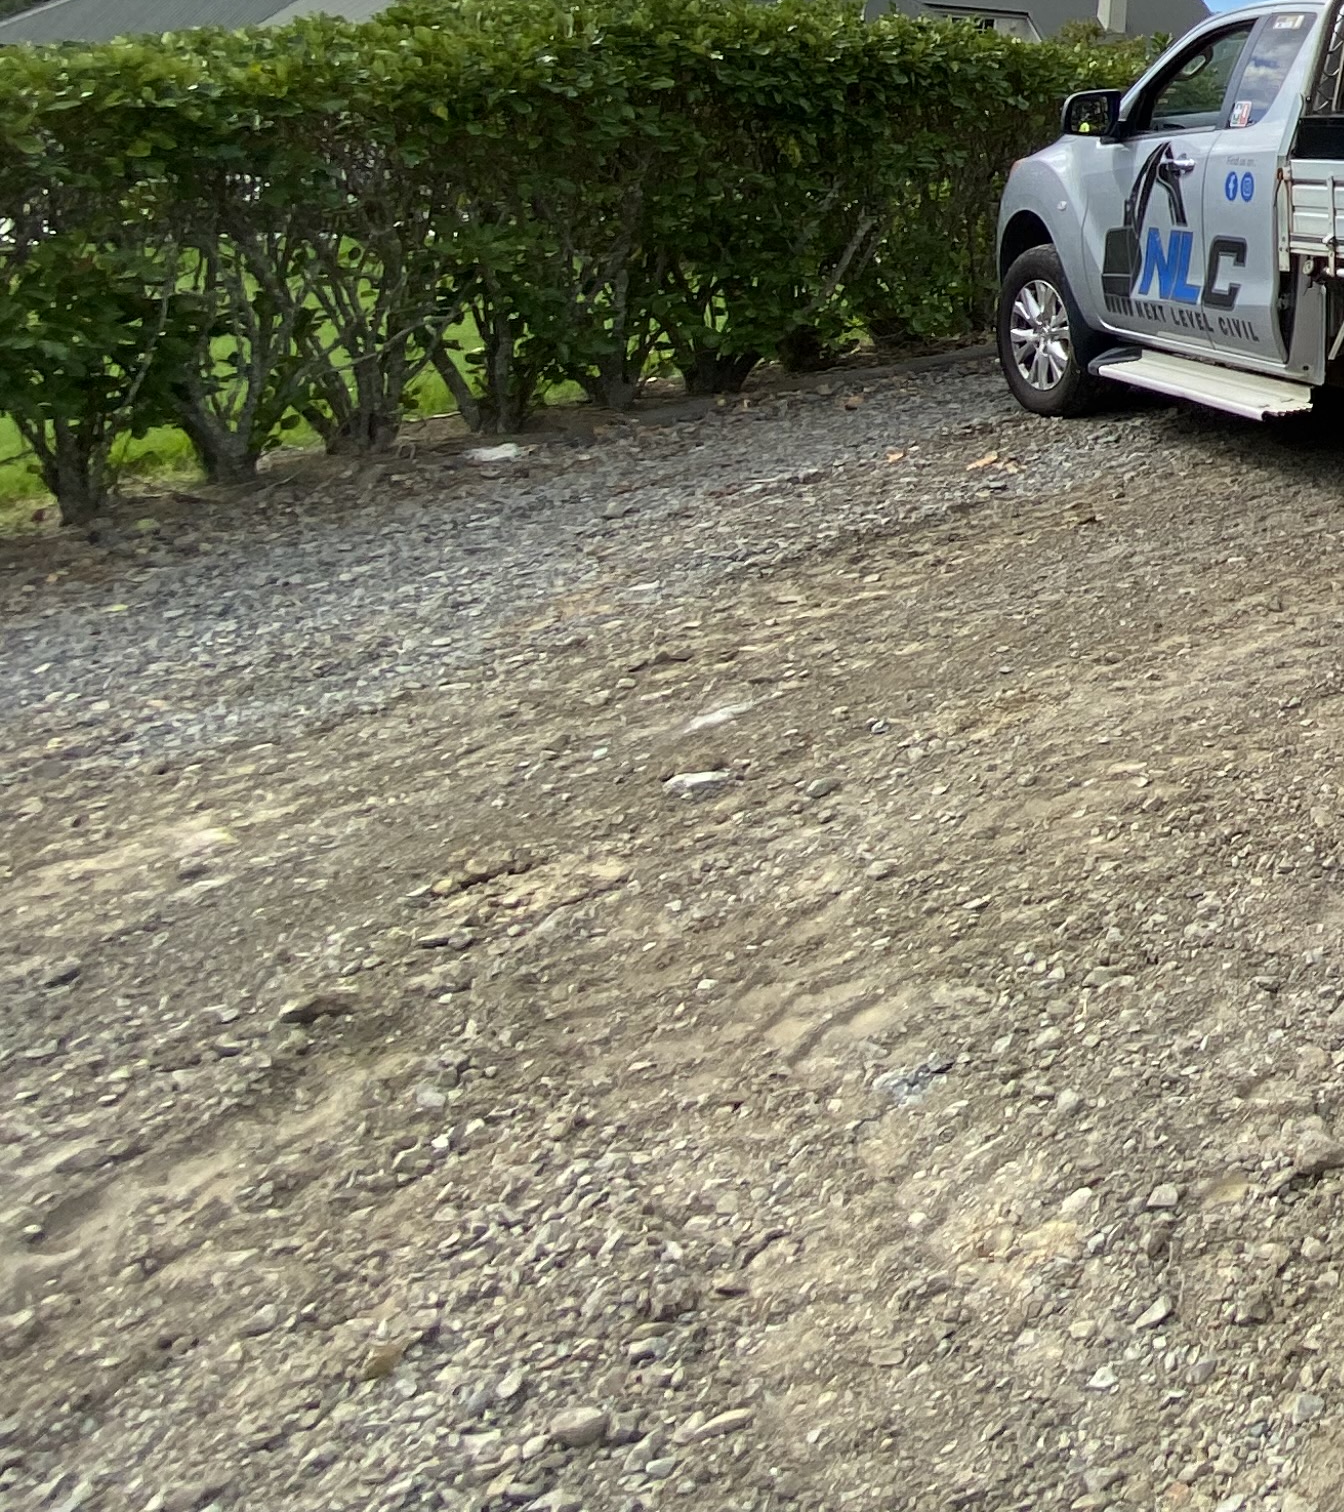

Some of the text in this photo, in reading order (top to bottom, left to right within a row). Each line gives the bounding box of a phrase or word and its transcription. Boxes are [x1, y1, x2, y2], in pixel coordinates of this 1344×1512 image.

[1138, 227, 1248, 312] NLC
[1136, 301, 1260, 342] NEXT LEVEL CIVIL
